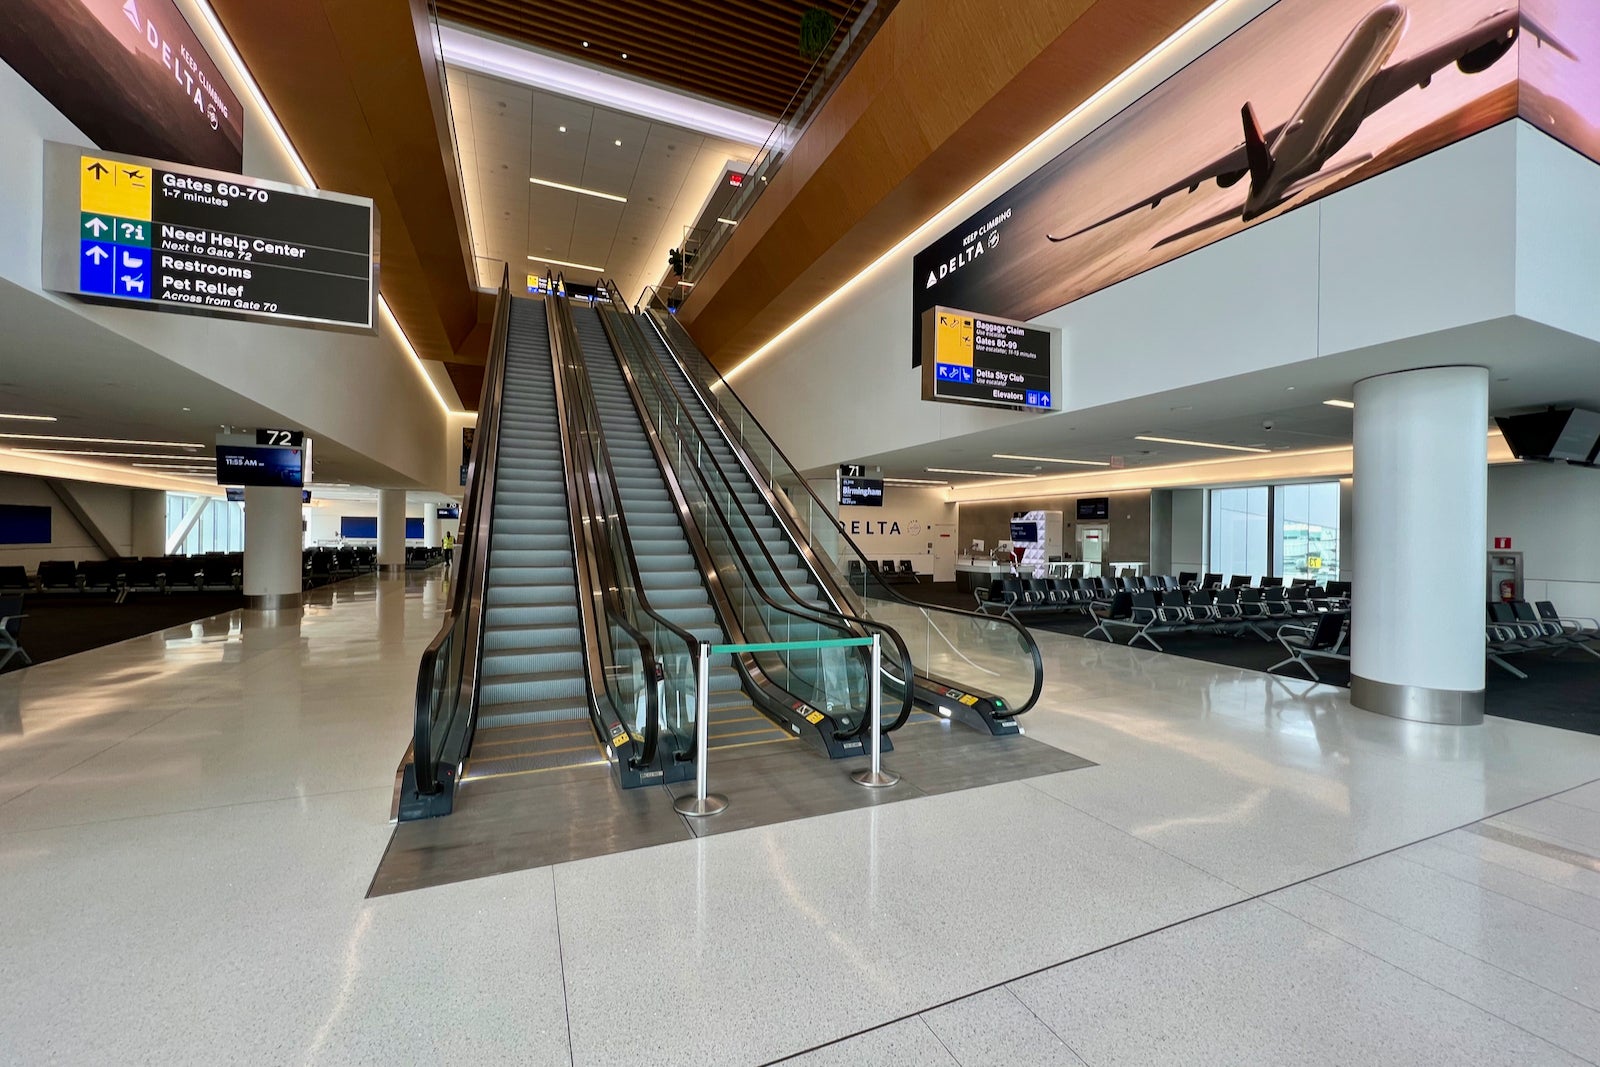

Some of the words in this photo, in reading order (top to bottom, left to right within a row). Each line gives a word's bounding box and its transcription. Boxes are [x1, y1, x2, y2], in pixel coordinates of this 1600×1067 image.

[147, 19, 204, 113] DELTA
[180, 44, 198, 73] KEEP
[198, 70, 228, 119] CLIMBING
[162, 173, 212, 193] Gates
[217, 183, 269, 203] 60-70
[162, 188, 181, 198] 1-7
[183, 192, 229, 207] minutes
[963, 230, 978, 247] KEEP
[979, 207, 1012, 236] CLIMBING
[161, 225, 206, 243] Need
[211, 233, 249, 251] Help
[253, 240, 306, 258] Center
[162, 240, 189, 251] Next
[193, 244, 203, 254] to
[207, 246, 235, 259] Gate
[238, 251, 252, 261] 72
[162, 256, 252, 279] Restrooms
[940, 241, 984, 279] DELTA
[162, 276, 191, 291] Pet
[195, 280, 244, 297] Relief
[162, 291, 202, 303] Across
[205, 296, 231, 307] from
[233, 300, 260, 311] Gate
[263, 302, 278, 312] 70
[976, 320, 1005, 333] Baggage
[1006, 325, 1025, 336] Claim
[976, 336, 996, 346] Gates
[997, 339, 1017, 349] 80-99
[976, 369, 994, 379] Delta
[995, 371, 1008, 381] Sky
[1009, 373, 1024, 383] Club
[992, 389, 1023, 400] Elevators
[266, 430, 291, 446] 72
[848, 465, 859, 476] 71
[843, 486, 881, 497] Birmingham
